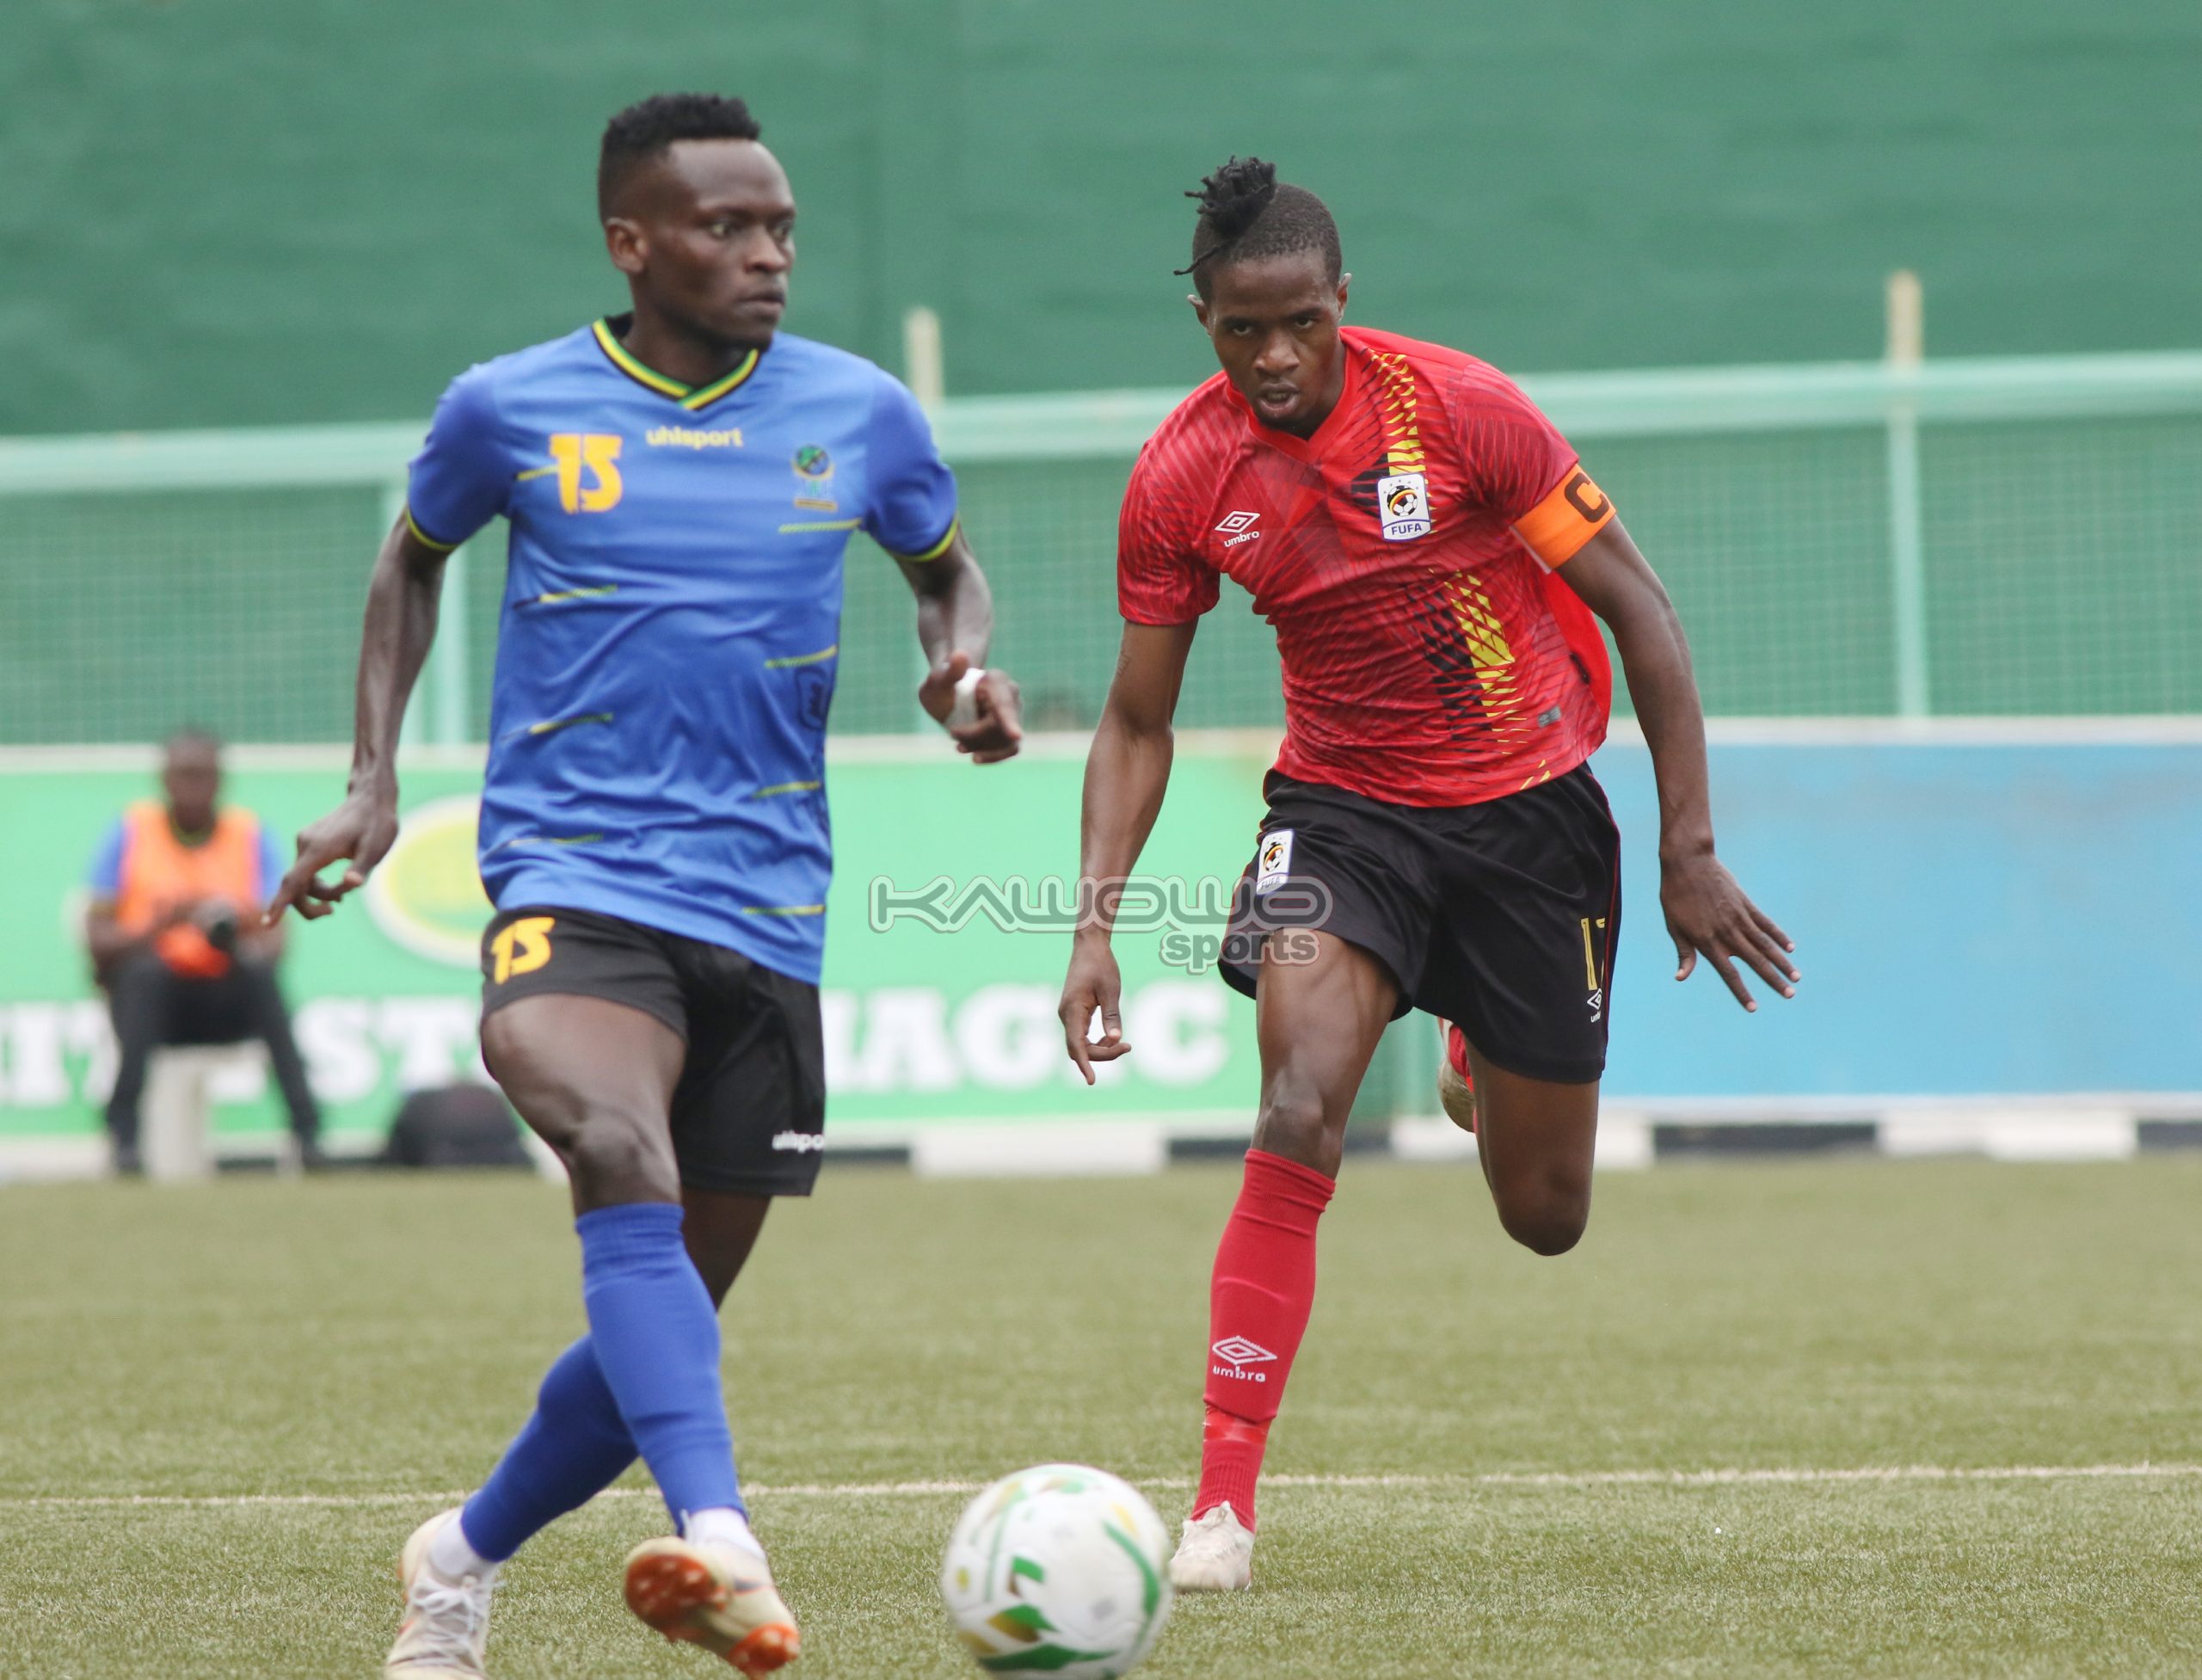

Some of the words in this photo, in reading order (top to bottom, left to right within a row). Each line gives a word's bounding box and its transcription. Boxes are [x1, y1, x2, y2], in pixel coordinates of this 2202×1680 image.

[646, 427, 743, 451] uhlsport
[550, 434, 622, 514] 15
[1564, 472, 1610, 523] C
[1223, 531, 1260, 547] umbro
[1391, 522, 1423, 535] FUFA
[490, 916, 556, 985] 15
[1212, 1365, 1266, 1382] umbro
